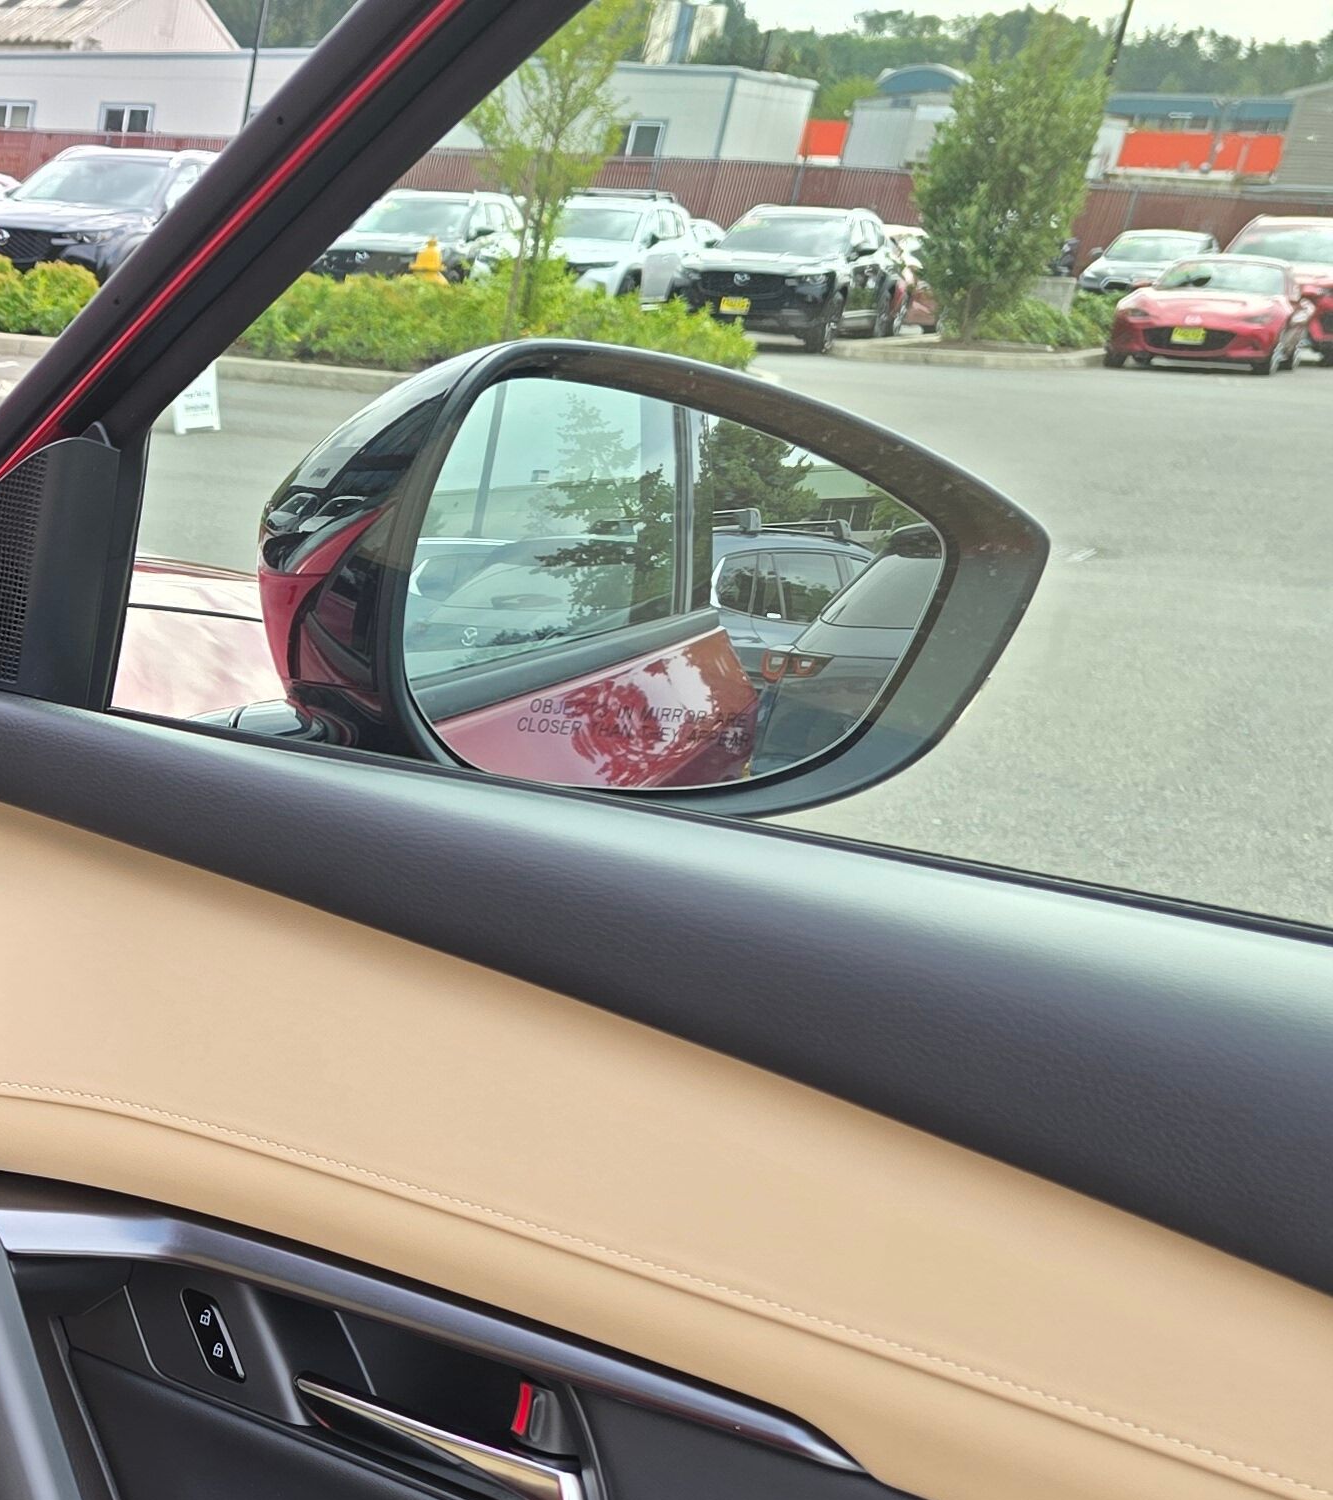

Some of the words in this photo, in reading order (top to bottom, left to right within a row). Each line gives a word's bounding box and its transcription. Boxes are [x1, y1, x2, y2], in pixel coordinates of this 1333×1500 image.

[530, 698, 607, 718] OBJECTS
[617, 704, 633, 720] IN
[641, 706, 707, 723] MIRROR
[716, 712, 750, 729] ARE
[516, 716, 582, 736] CLOSER
[593, 723, 633, 739] THAN
[640, 727, 680, 744] THEY
[686, 729, 752, 748] APPEAR
